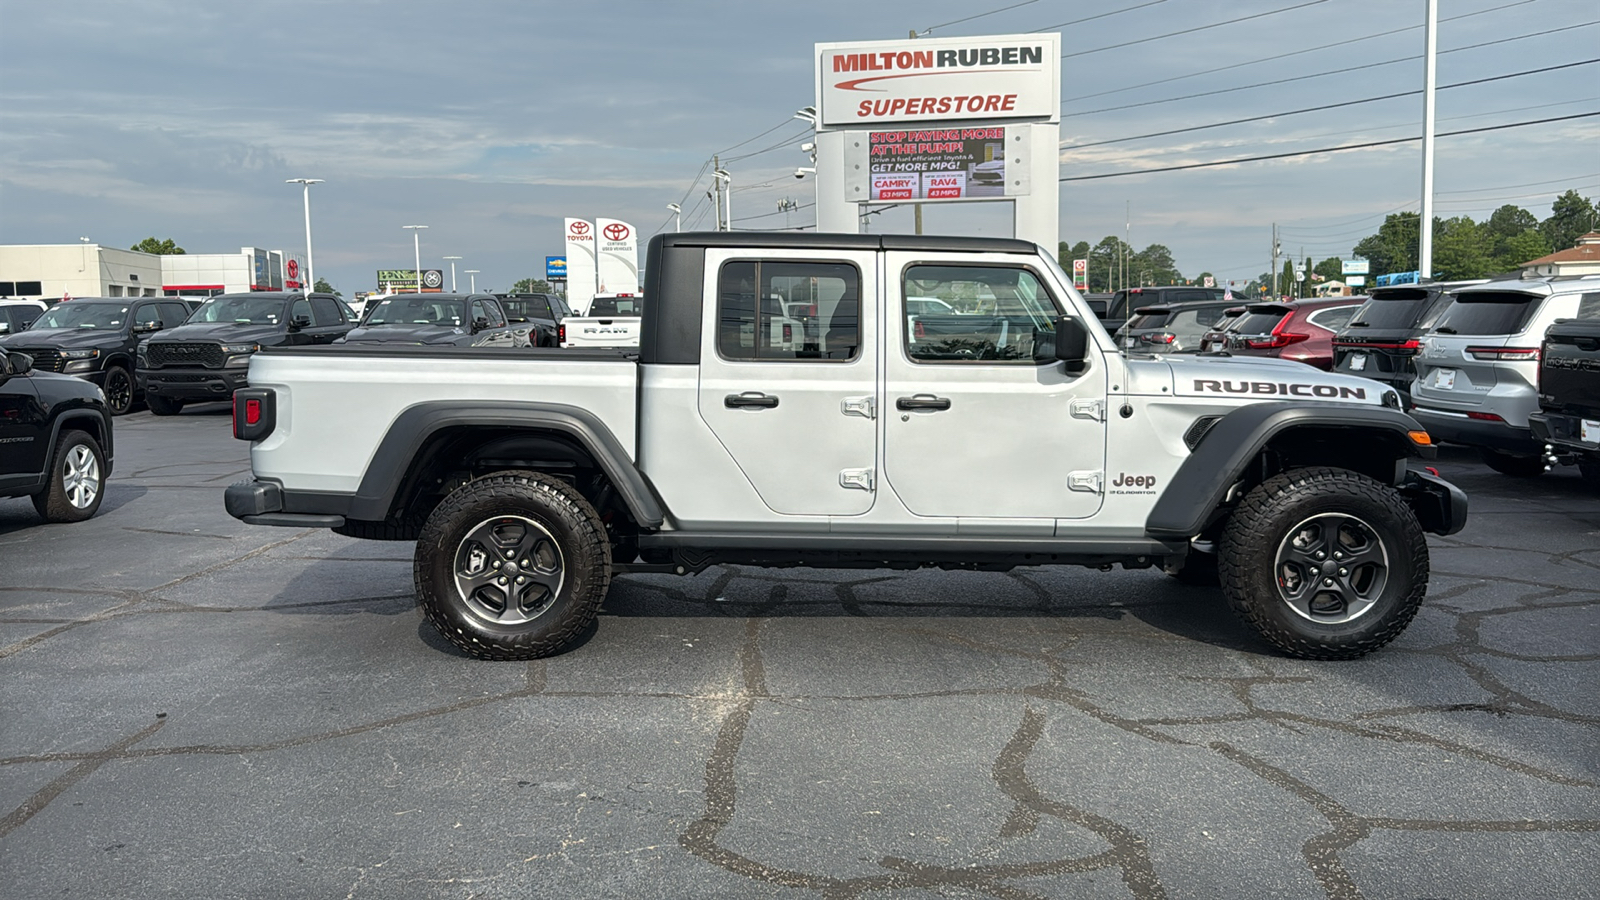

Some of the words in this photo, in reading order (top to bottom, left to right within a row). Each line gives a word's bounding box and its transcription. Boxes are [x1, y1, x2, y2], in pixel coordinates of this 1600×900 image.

[833, 50, 933, 72] MILTON
[937, 46, 1042, 68] RUBEN
[857, 94, 1018, 117] SUPERSTORE
[870, 131, 907, 143] STOP
[908, 129, 960, 142] PAYING
[961, 127, 1004, 140] MORE
[870, 144, 888, 155] AT
[890, 143, 917, 155] THE
[918, 142, 964, 154] PUMP!
[944, 154, 967, 162] Toyota
[871, 163, 894, 172] GET
[894, 162, 928, 172] MORE
[930, 161, 961, 171] MPG!
[874, 180, 911, 189] CAMRY
[930, 178, 957, 187] RAV4
[1193, 379, 1367, 400] RUBICON
[1112, 472, 1157, 489] Jeep
